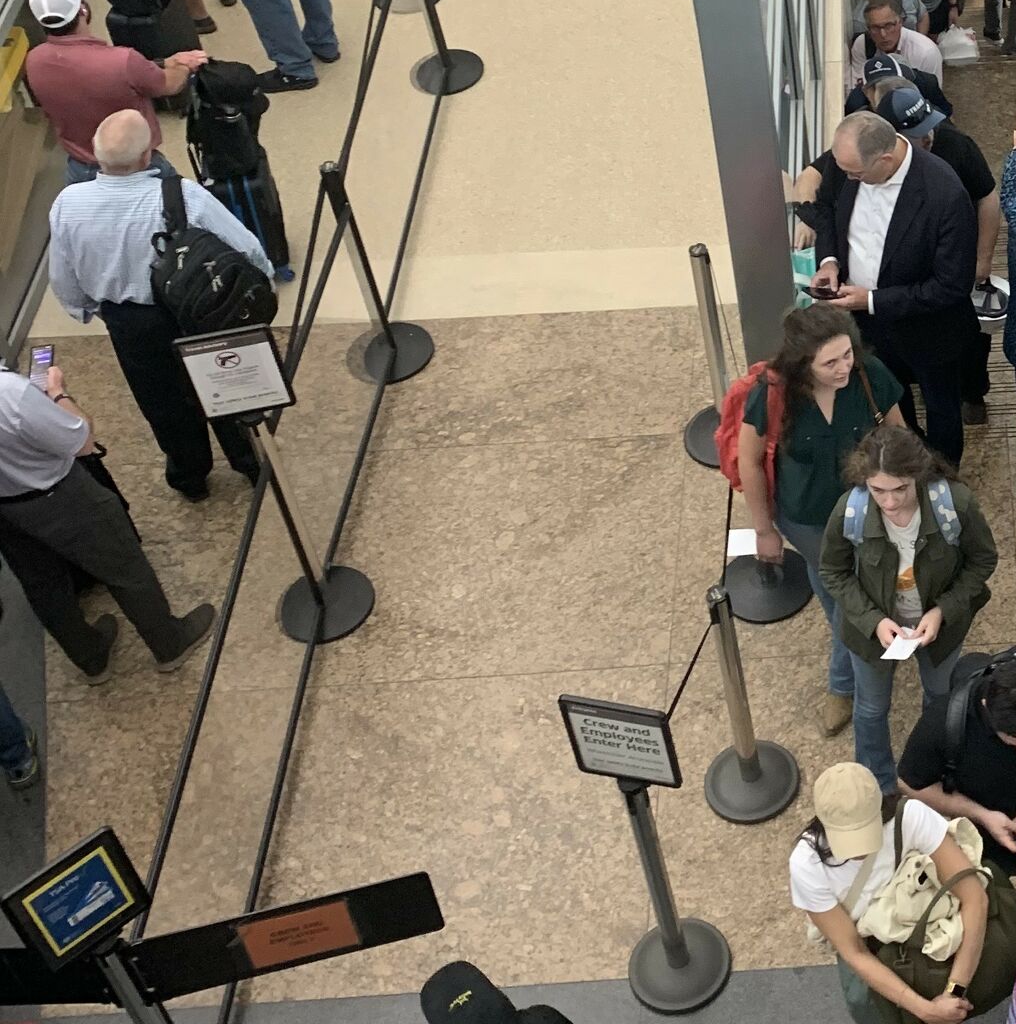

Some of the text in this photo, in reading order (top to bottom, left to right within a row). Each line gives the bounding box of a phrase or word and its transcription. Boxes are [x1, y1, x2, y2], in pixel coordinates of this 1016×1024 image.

[580, 726, 660, 747] Employees
[583, 718, 651, 737] Crew and
[583, 736, 661, 756] Enter Here
